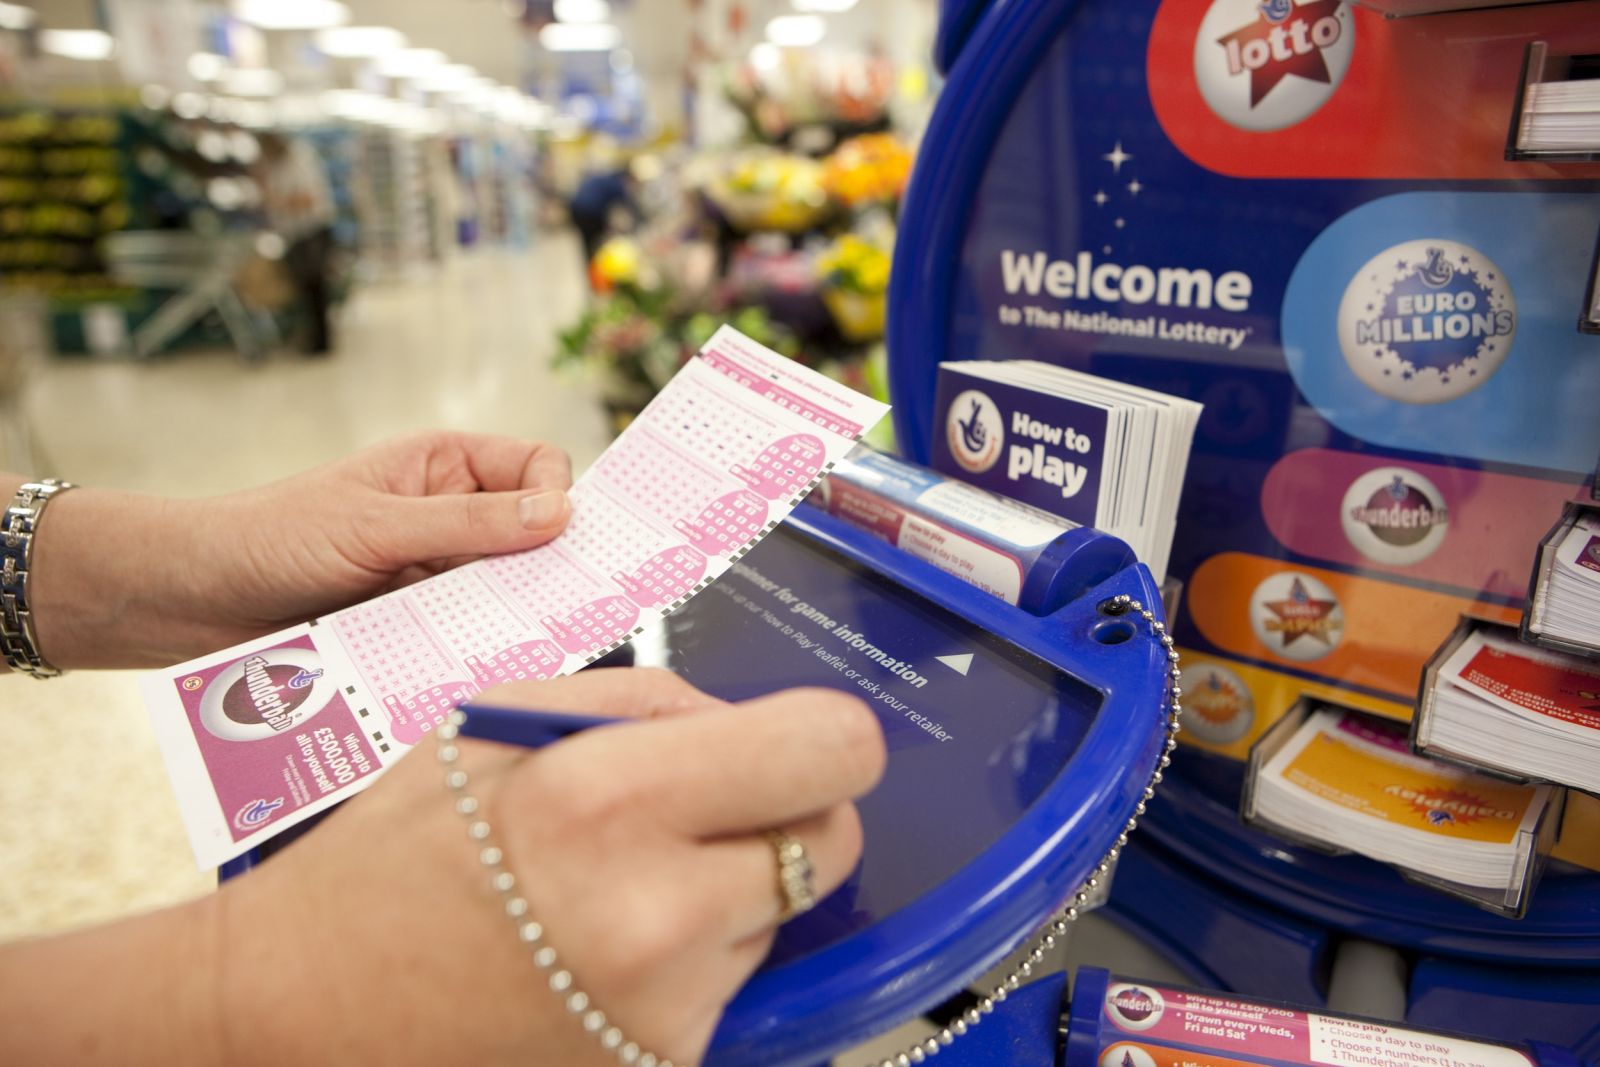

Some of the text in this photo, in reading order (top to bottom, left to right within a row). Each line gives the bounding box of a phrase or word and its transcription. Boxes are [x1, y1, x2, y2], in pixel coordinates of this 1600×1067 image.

[1226, 15, 1341, 76] lotto
[1000, 250, 1252, 312] Welcome
[1396, 291, 1477, 316] EURO
[999, 305, 1248, 350] to The National Lottery
[1357, 309, 1515, 345] MILLIONS
[1012, 411, 1063, 446] How
[1064, 427, 1091, 454] to
[1007, 443, 1088, 498] play
[773, 588, 800, 604] for
[790, 602, 837, 630] game
[832, 624, 928, 688] information
[244, 656, 293, 731] Thunderball
[780, 624, 794, 635] to
[813, 646, 850, 672] leaflet
[844, 669, 862, 679] or
[857, 678, 880, 694] ask
[874, 691, 909, 711] your
[904, 710, 954, 742] retailer
[1503, 693, 1546, 712] match
[1547, 709, 1576, 720] and
[296, 733, 336, 794] all to yourself
[313, 727, 356, 784] £500,000
[343, 733, 371, 773] Win up to
[1185, 1001, 1265, 1020] all to yourself
[1186, 994, 1295, 1018] Win up to £500,000
[1184, 1022, 1246, 1040] Fri and Sat
[1185, 1011, 1295, 1039] Drawn every Weds,
[1319, 1017, 1388, 1034] How to play
[1329, 1027, 1372, 1041] Choose
[1385, 1036, 1407, 1048] day
[1409, 1040, 1422, 1049] to
[1424, 1043, 1450, 1055] play
[1330, 1038, 1373, 1054] Choose
[1375, 1045, 1383, 1055] 5
[1385, 1048, 1437, 1065] numbers
[1331, 1049, 1410, 1067] 1 Thunderball
